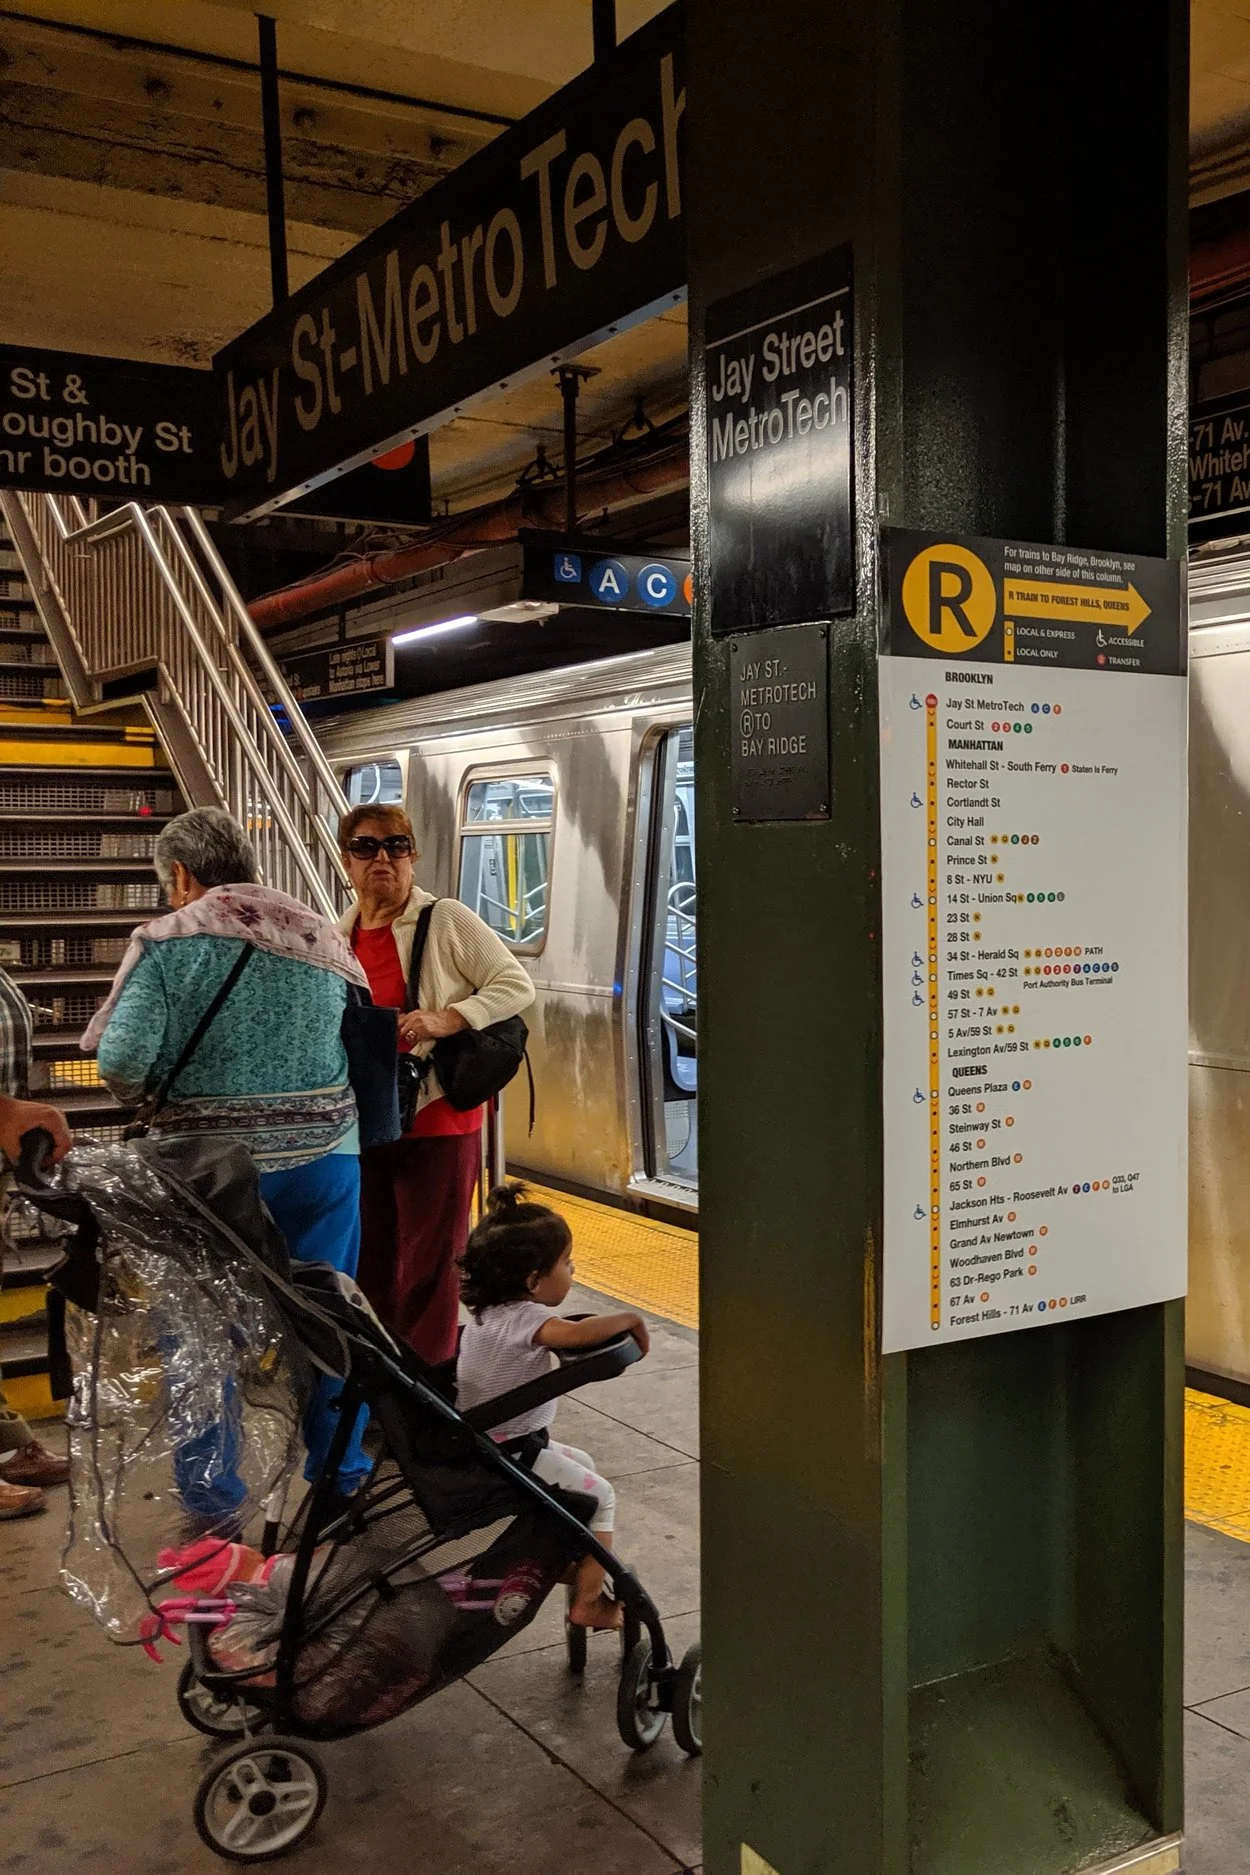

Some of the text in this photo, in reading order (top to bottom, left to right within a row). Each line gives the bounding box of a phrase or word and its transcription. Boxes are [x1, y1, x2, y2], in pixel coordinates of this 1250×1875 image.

[713, 310, 844, 403] Jay Street
[11, 368, 89, 404] St &
[220, 365, 281, 483] Jay
[713, 377, 847, 462] MetroTech
[155, 422, 193, 453] St
[1221, 418, 1248, 443] Av.
[44, 447, 150, 485] booth
[1004, 546, 1122, 569] For trains Bay Ridge, Brooklyn,
[929, 560, 978, 637] R
[1009, 591, 1013, 600] R
[1016, 592, 1038, 601] TRAIN
[1040, 594, 1049, 603] TO
[1052, 594, 1078, 606] FOREST
[1104, 600, 1129, 611] QUEENS
[1017, 628, 1039, 637] LOCAL
[1047, 630, 1075, 639] EXPRESS
[1108, 638, 1144, 647] ACCESSIBLE
[1017, 648, 1058, 658] LOCAL ONLY
[1109, 657, 1140, 666] TRANSFER
[741, 663, 761, 681] JAY
[946, 672, 993, 684] BROOKLYN
[741, 682, 816, 706] METROTECH
[947, 699, 1024, 711] Jay St MetroTech
[755, 713, 770, 730] TO
[947, 720, 984, 730] Court St
[742, 736, 806, 757] BAY RIDGE
[948, 740, 1003, 750] MANHATTAN
[946, 759, 1056, 774] Whitehall St South Ferry
[947, 779, 989, 788] Rector St
[947, 798, 1000, 807] Cortlandt St
[947, 817, 984, 827] City Hall
[947, 836, 984, 845] Canal St
[947, 856, 987, 865] Prince St
[973, 875, 992, 884] NYU
[978, 894, 1017, 904] Union Sq
[978, 950, 1019, 960] Herald Sq
[948, 971, 988, 981] Times Sq
[948, 1043, 1017, 1058] Lexington Av/59
[952, 1065, 987, 1078] QUEENS
[948, 1083, 1008, 1097] Queens Plaza
[949, 1120, 1001, 1134] Steinway St
[950, 1156, 1010, 1172] Northern Blvd
[950, 1186, 1068, 1211] Jackson Hts Roosevelt Av
[950, 1214, 1003, 1230] Elmhurst Av
[950, 1229, 1034, 1249] Grand Av Newtown
[950, 1248, 1024, 1268] Woodhaven Blvd
[964, 1268, 1023, 1286] Dr-Rego Park
[950, 1311, 1001, 1326] Forest Hills
